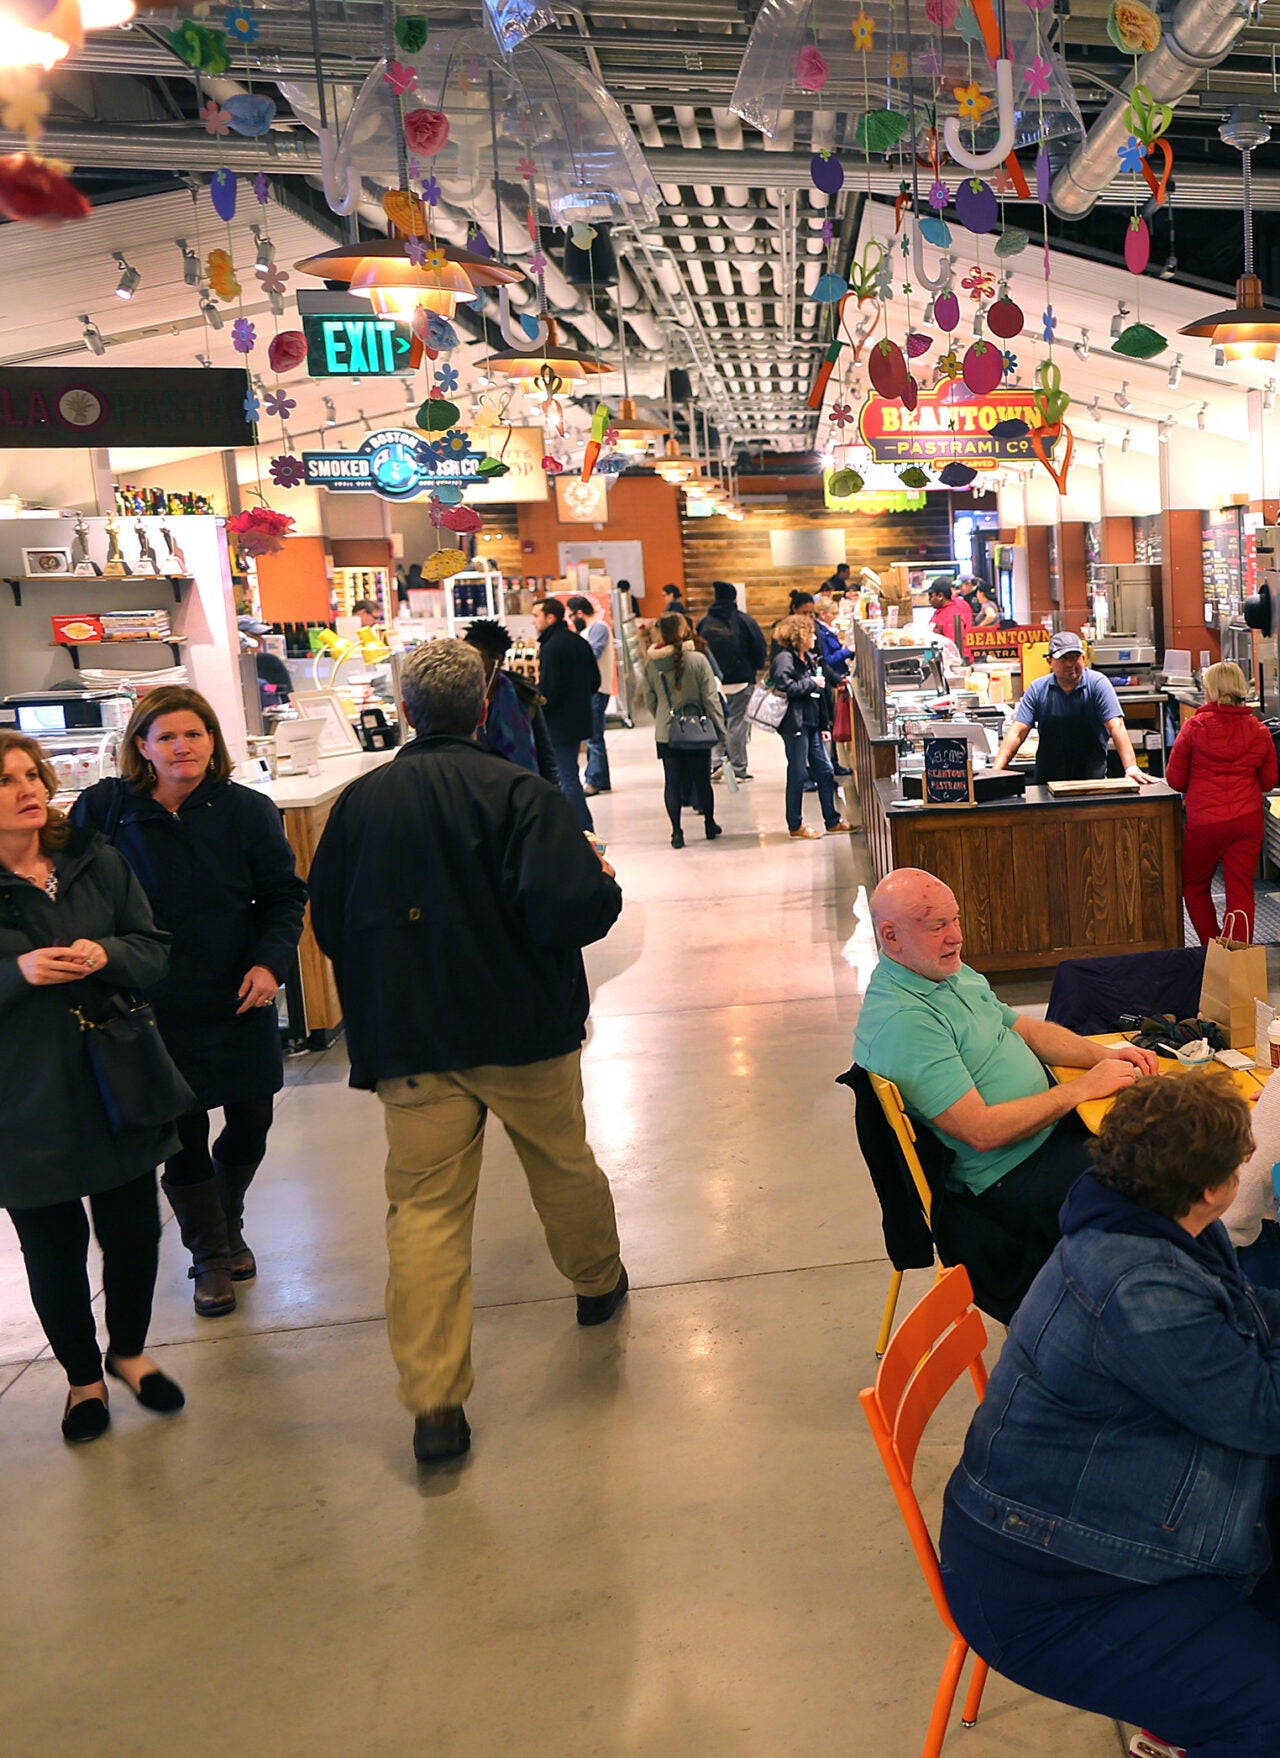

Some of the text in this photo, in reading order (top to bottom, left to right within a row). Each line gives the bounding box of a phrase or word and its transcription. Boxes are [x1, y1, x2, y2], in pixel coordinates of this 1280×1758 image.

[322, 321, 396, 373] EXIT
[112, 390, 232, 427] PASTA
[881, 404, 1042, 432] BEANTOWN
[369, 432, 419, 449] BOSTON
[897, 441, 1000, 454] PASTRAMI
[308, 459, 370, 477] SMOKED
[965, 629, 1050, 646] BEANTOWN
